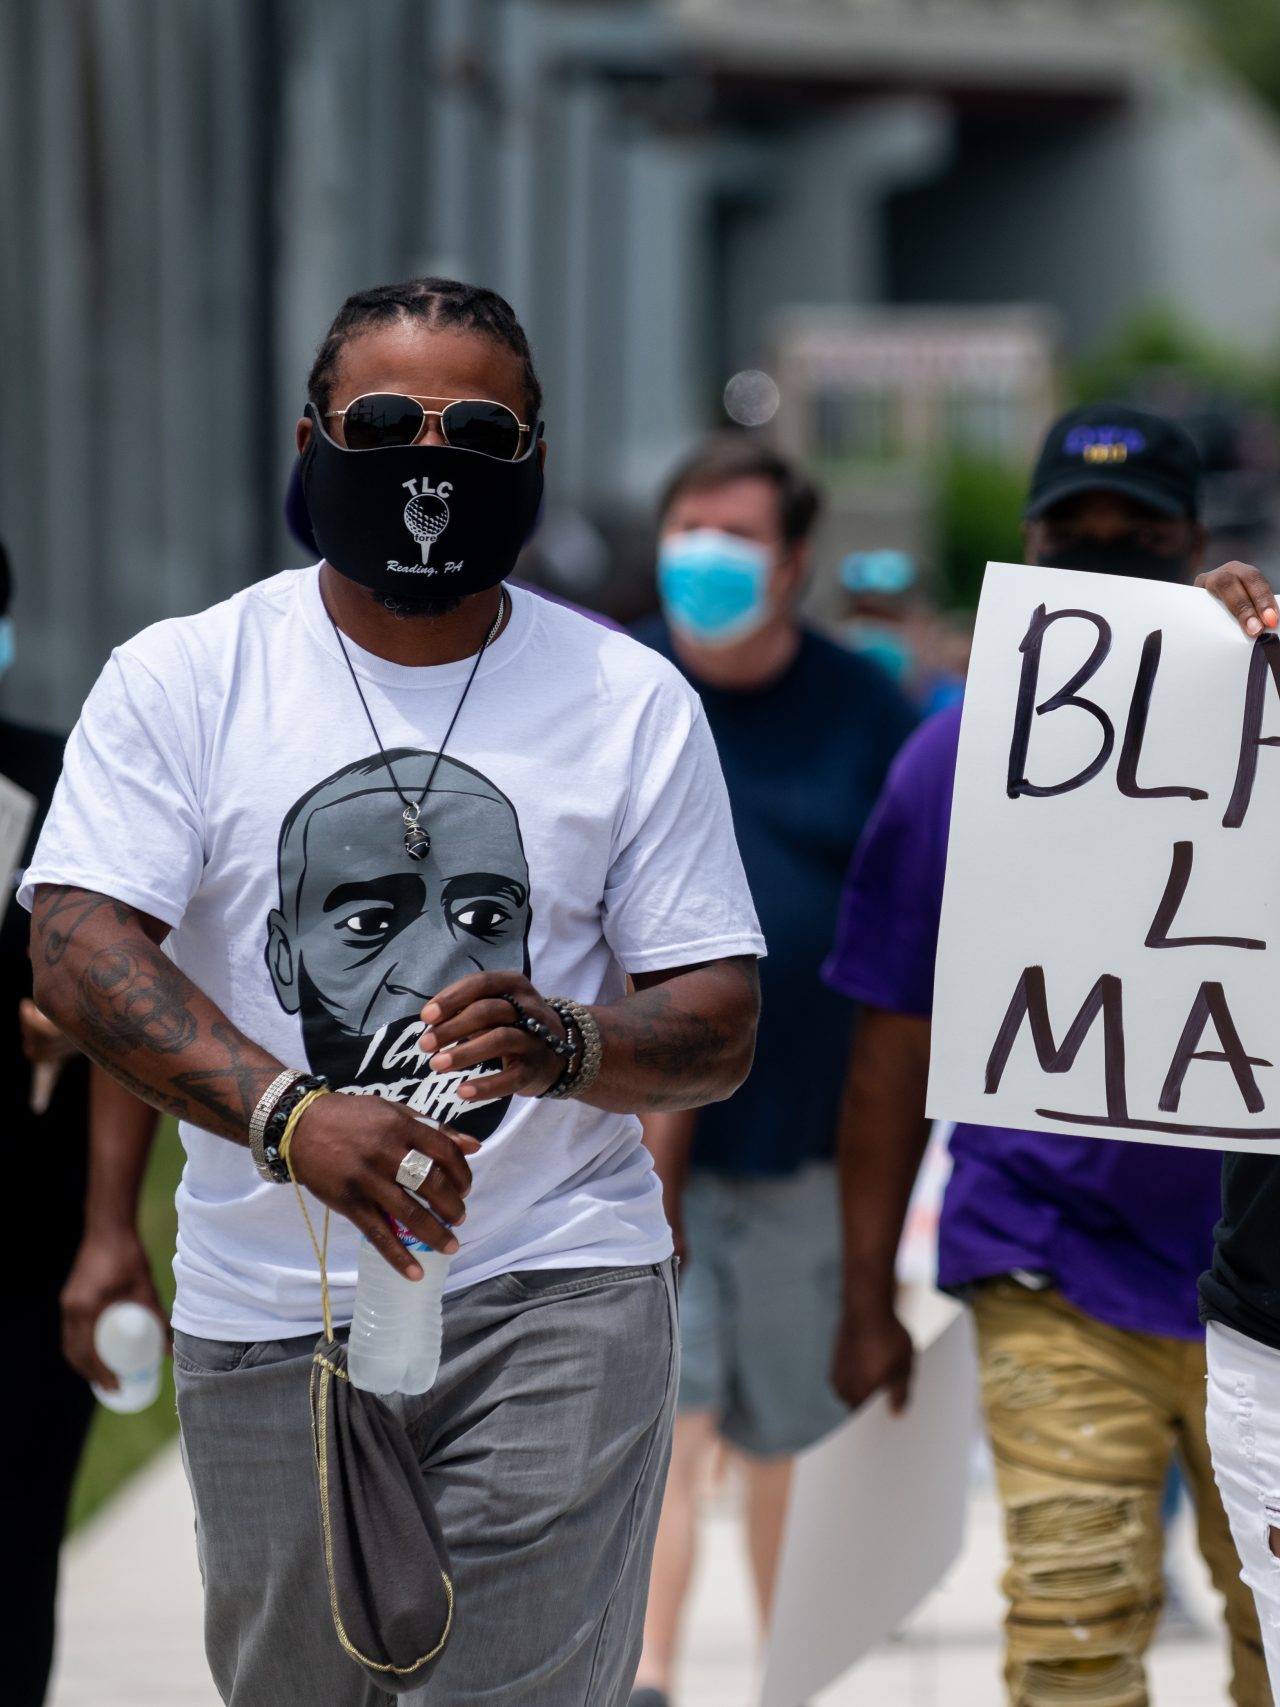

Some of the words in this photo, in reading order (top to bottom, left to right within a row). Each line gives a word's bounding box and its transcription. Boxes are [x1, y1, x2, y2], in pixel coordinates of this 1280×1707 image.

[401, 476, 454, 499] TLC
[414, 533, 437, 543] fore
[386, 560, 439, 578] Reading,
[443, 559, 464, 574] PA
[354, 1023, 389, 1080] I
